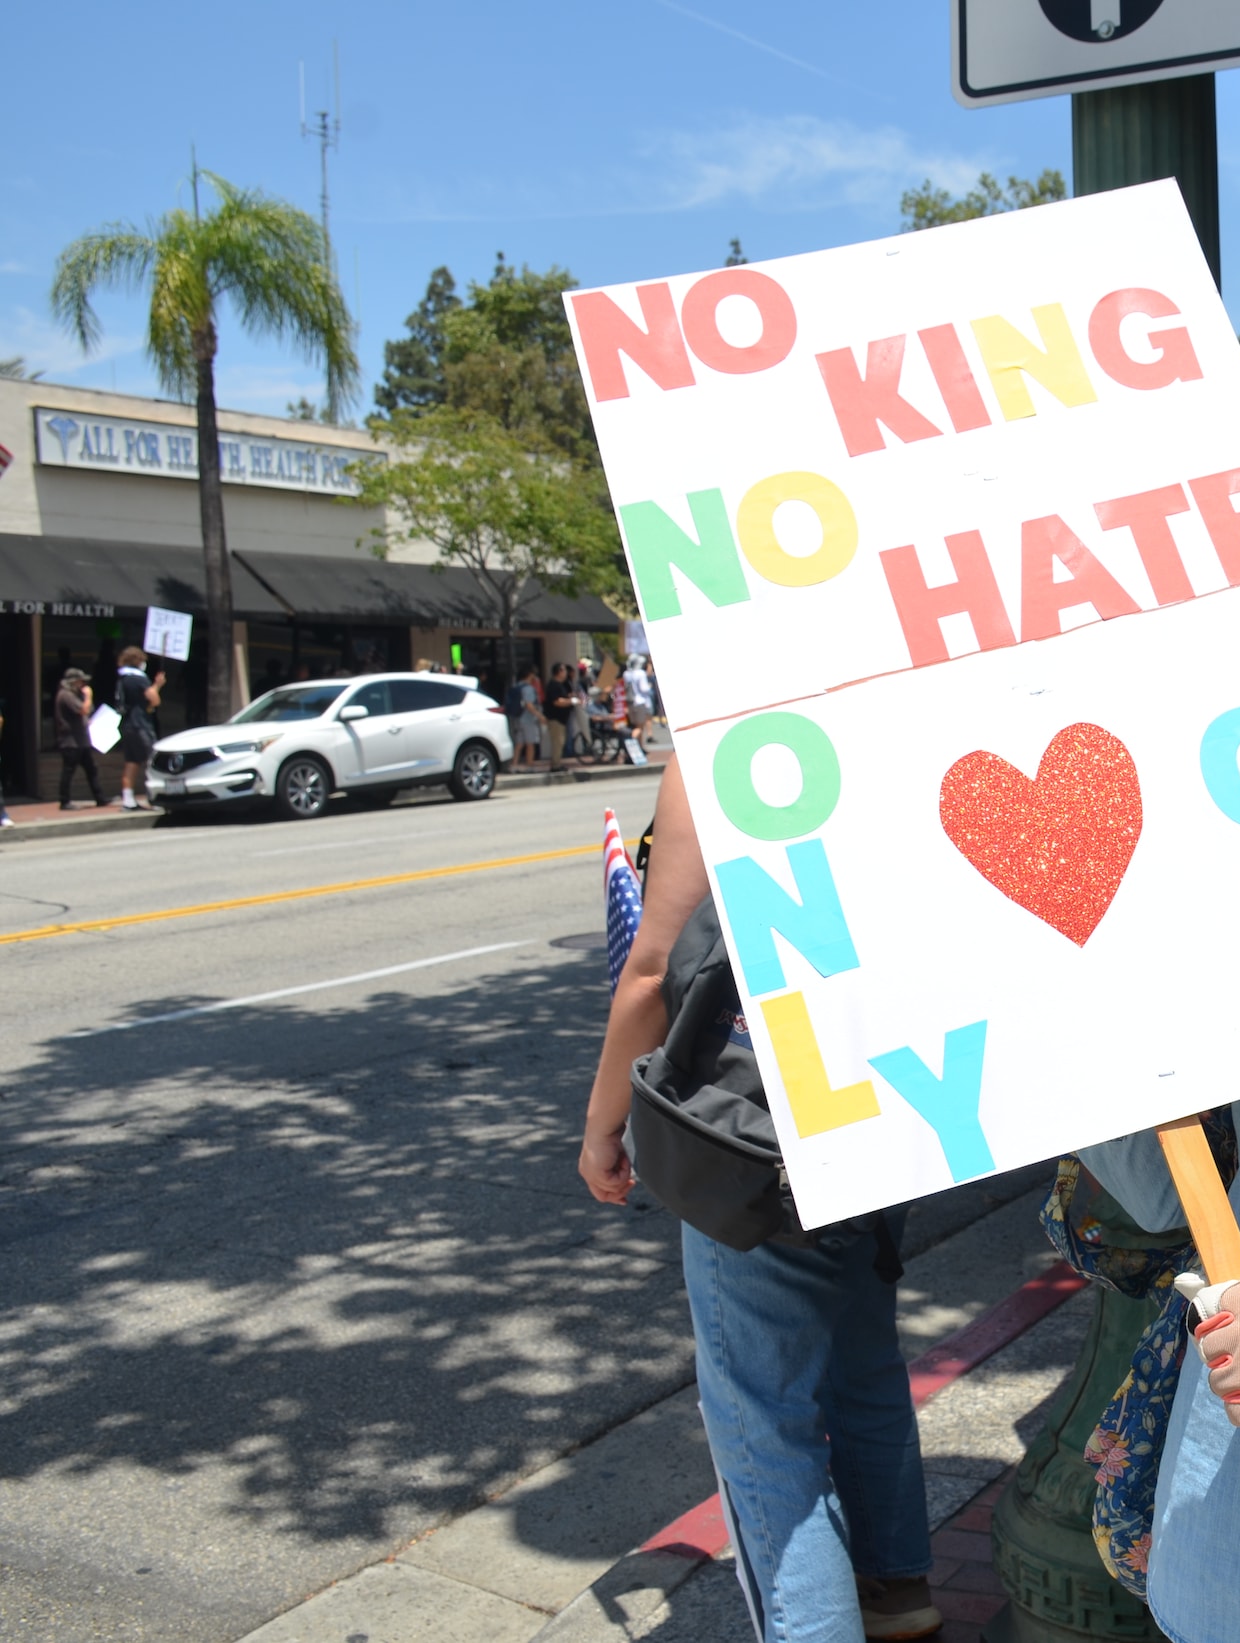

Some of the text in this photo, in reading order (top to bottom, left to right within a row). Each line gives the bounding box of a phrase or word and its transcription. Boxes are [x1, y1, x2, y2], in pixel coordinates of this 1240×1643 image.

[571, 269, 1204, 457] NO KING
[80, 424, 119, 464] ALL
[124, 429, 162, 468] FOR
[167, 435, 246, 480] HETH,
[250, 445, 318, 484] HEALTH
[14, 602, 46, 614] FOR
[52, 603, 115, 618] HEALTH
[619, 471, 858, 622] NO
[713, 712, 996, 1182] ONLY
